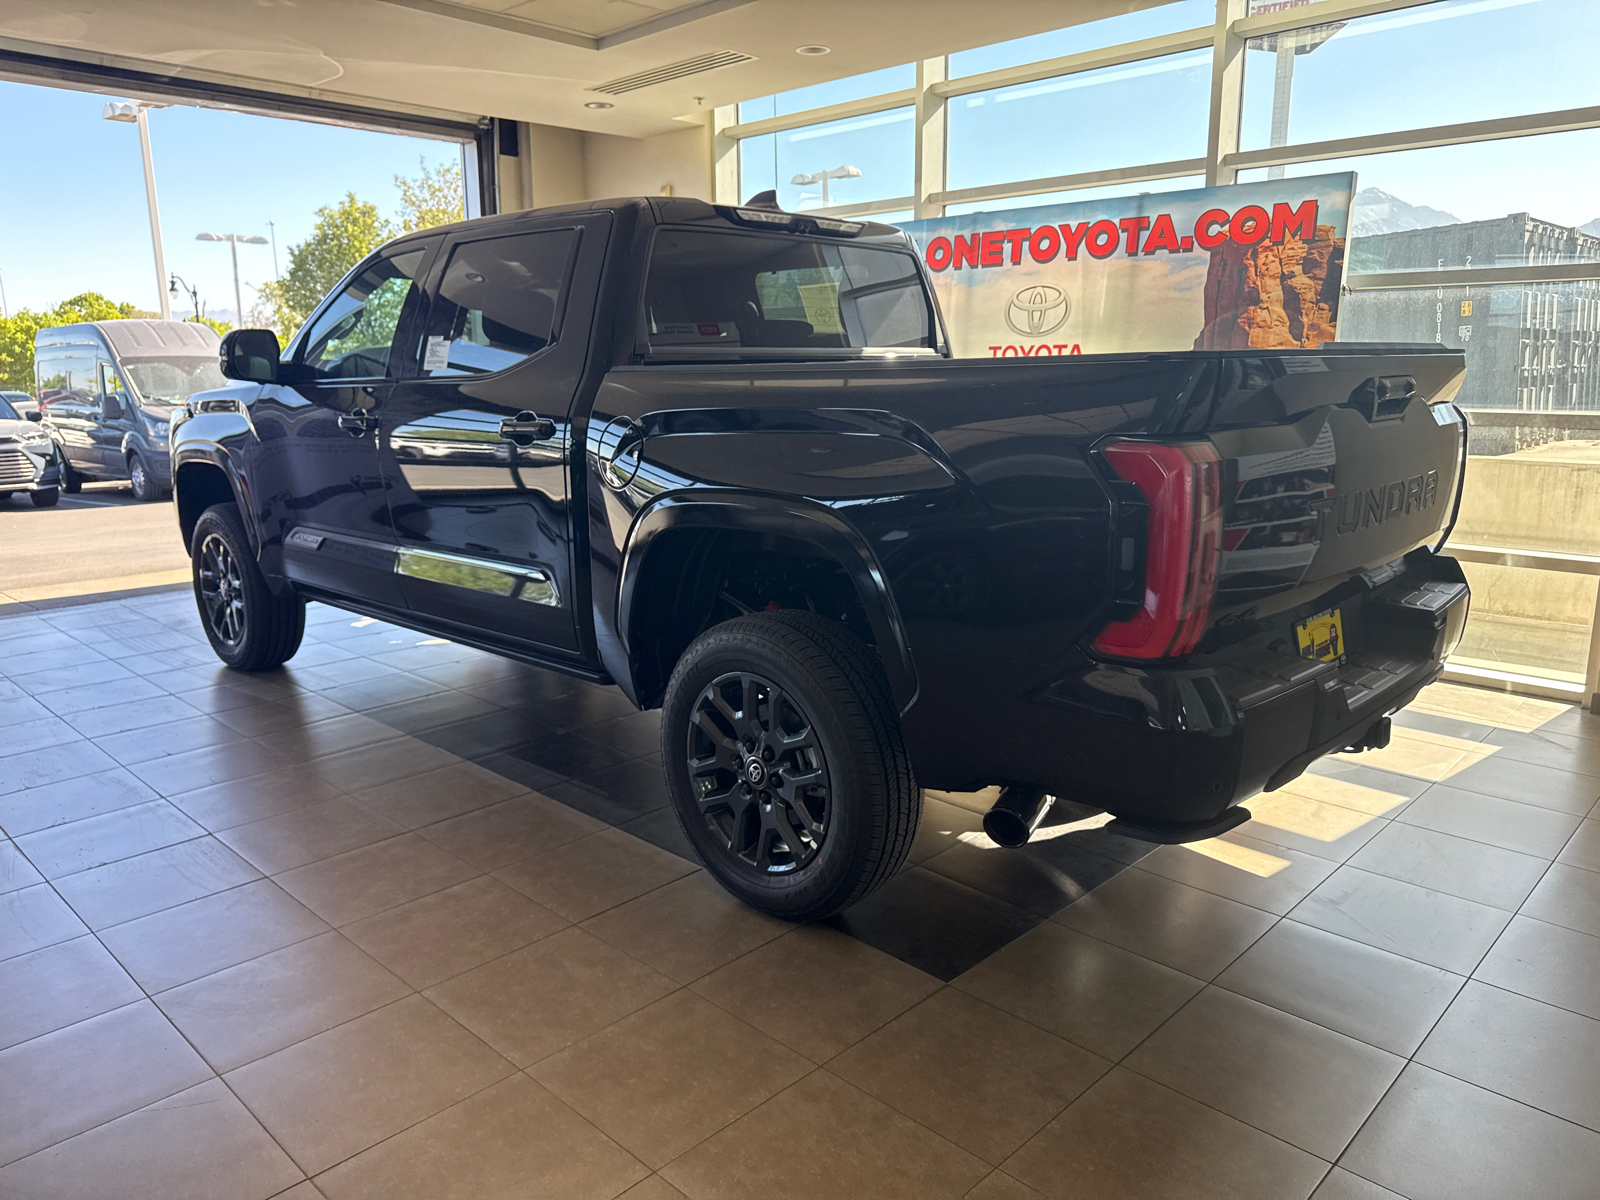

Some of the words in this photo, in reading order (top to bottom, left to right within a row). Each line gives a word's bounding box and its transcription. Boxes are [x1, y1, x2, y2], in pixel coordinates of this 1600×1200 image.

[924, 199, 1319, 272] ONETOYOTA.COM
[988, 344, 1082, 358] TOYOTA
[1308, 469, 1438, 544] TUNDRA
